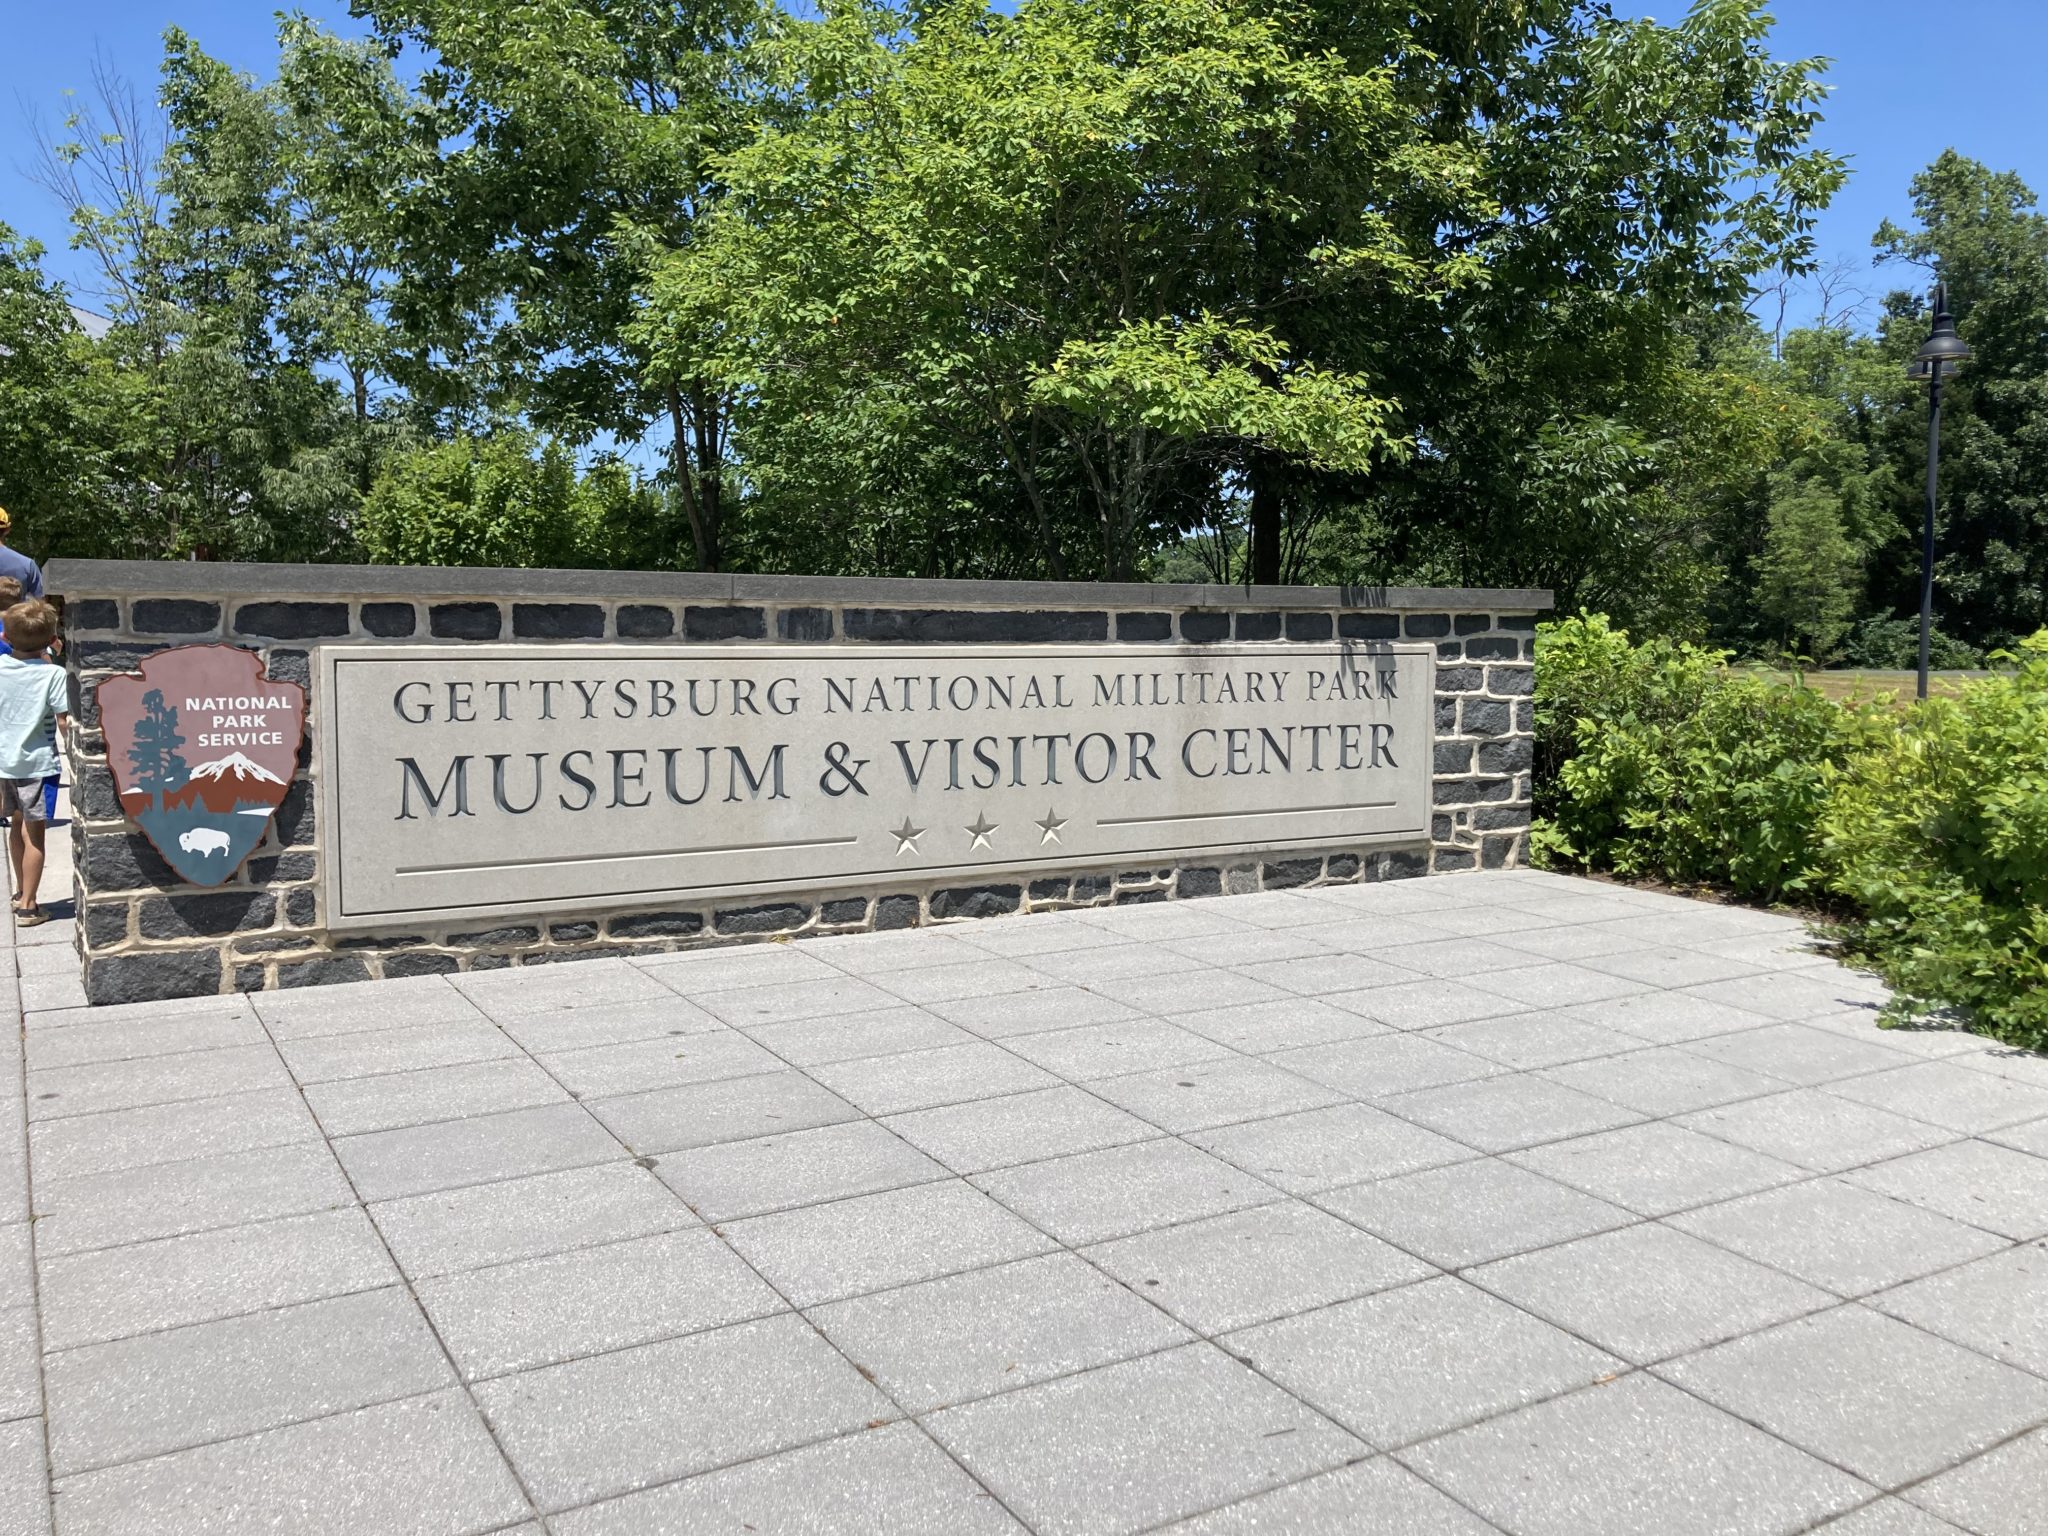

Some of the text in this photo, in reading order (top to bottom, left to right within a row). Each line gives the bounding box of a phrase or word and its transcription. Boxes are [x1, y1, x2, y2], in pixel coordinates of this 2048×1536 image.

[185, 697, 292, 711] NATIONAL
[393, 670, 1399, 723] GETTYSBURG NATIONAL MILITARY PARK
[212, 715, 266, 728] PARK
[198, 732, 283, 747] SERVICE
[394, 723, 1400, 820] MUSEUM & VISITOR CENTER
